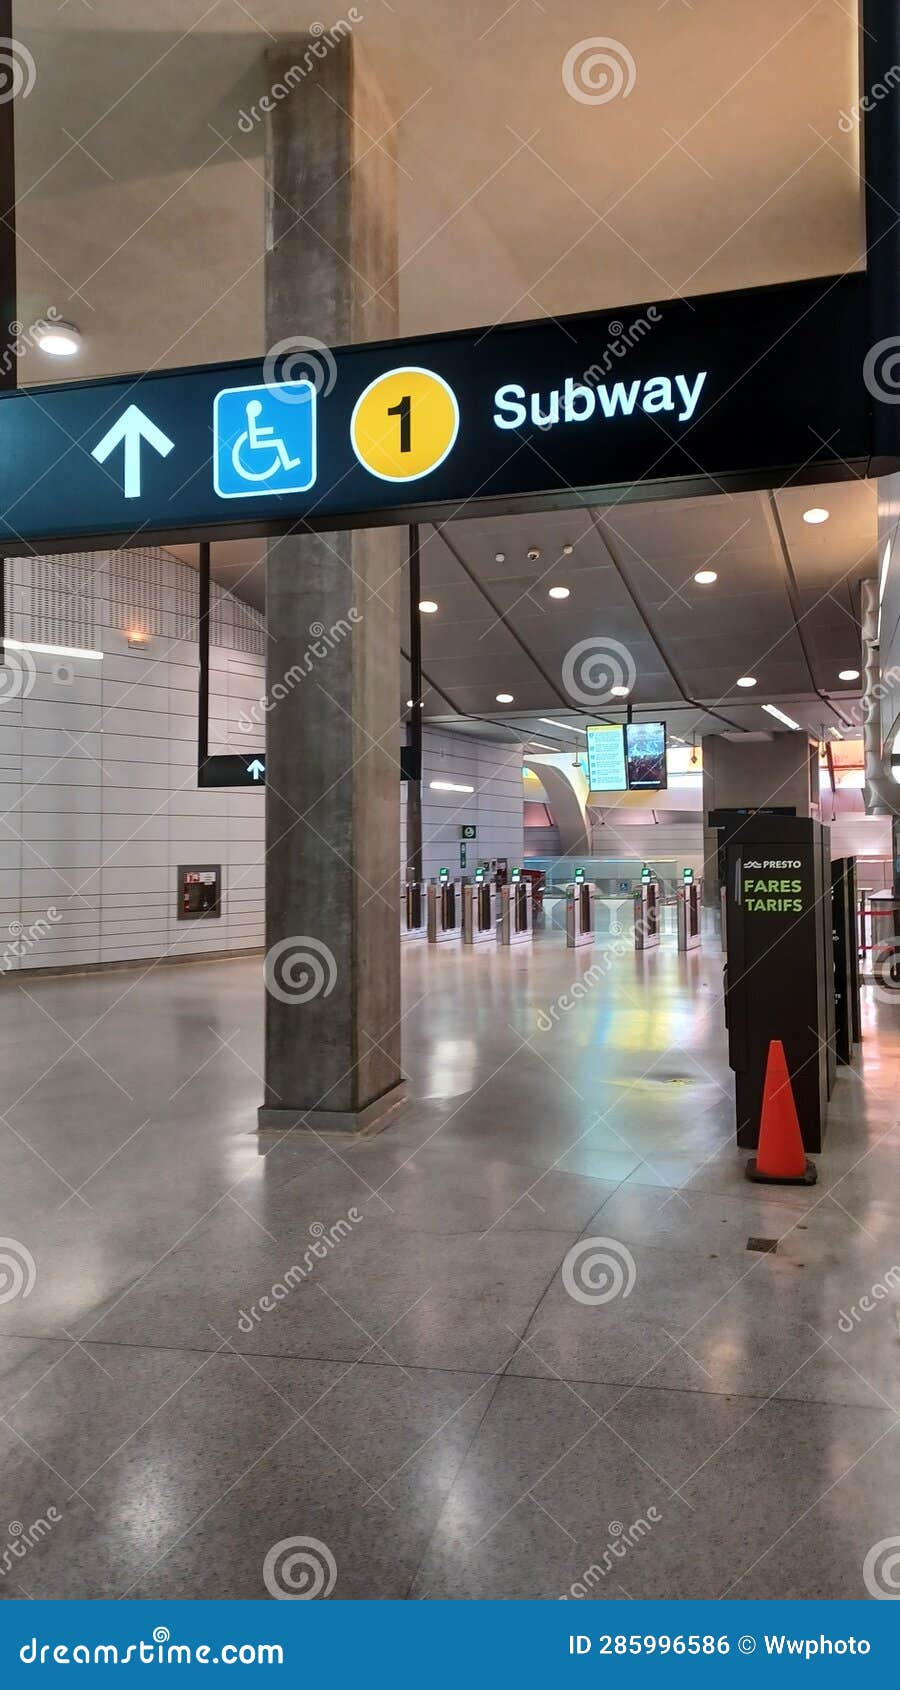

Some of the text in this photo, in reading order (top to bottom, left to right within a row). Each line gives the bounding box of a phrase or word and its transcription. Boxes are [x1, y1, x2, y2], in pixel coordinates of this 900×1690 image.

[388, 371, 707, 453] 1 Subway
[763, 860, 802, 869] PRESTO
[744, 880, 802, 893] FARES
[745, 899, 803, 912] TARIFS
